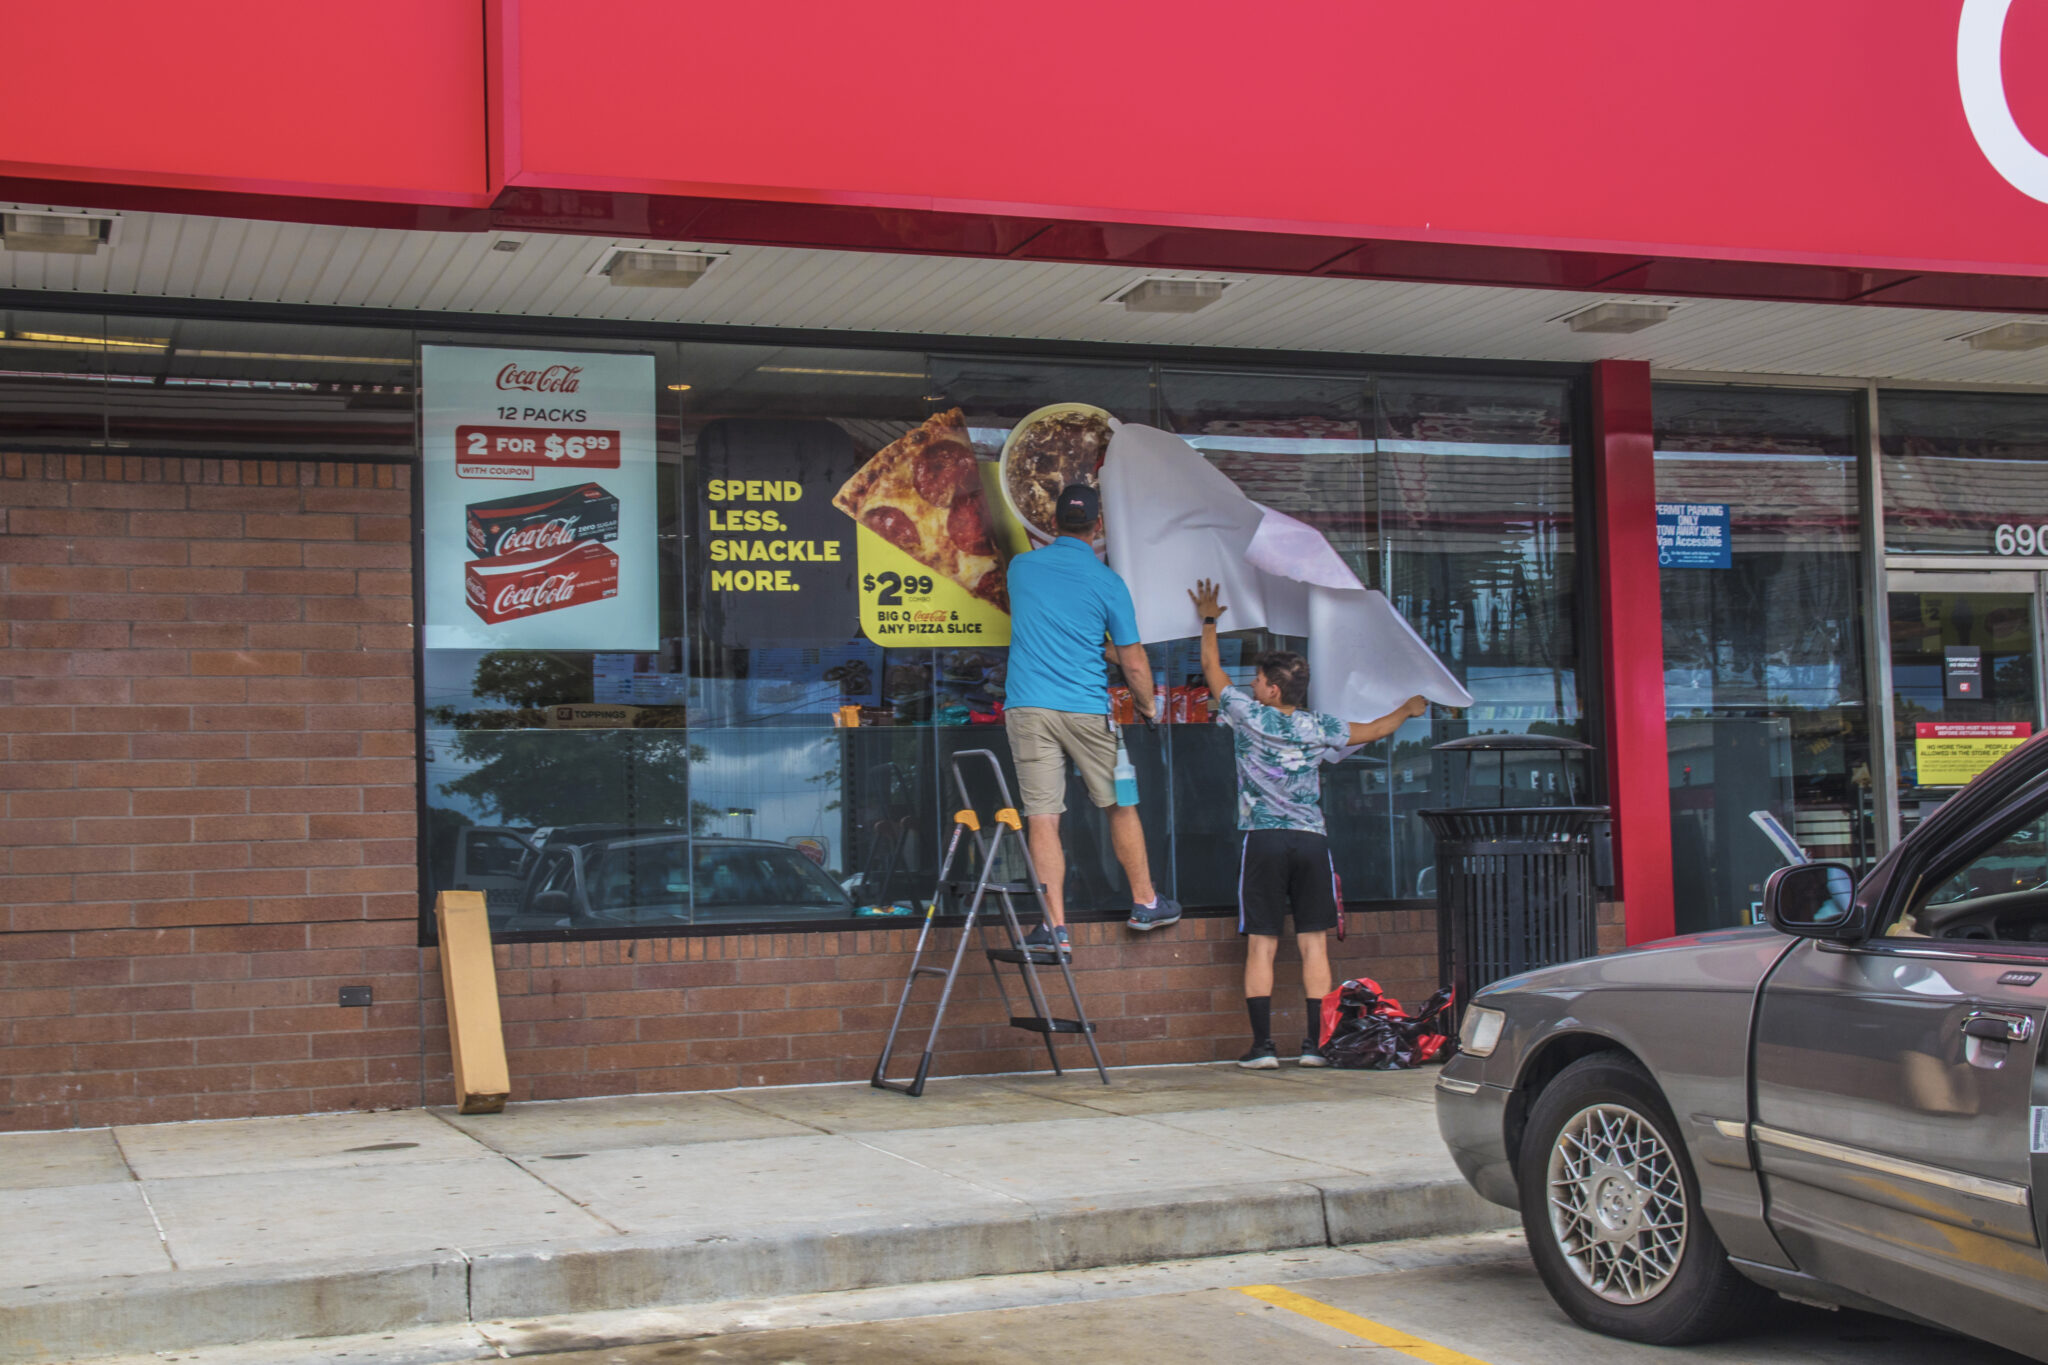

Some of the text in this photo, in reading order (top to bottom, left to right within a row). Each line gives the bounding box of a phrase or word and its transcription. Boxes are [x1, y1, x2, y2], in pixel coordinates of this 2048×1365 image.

[496, 363, 584, 393] Coca-Cola
[497, 407, 587, 422] 12 PACKS
[467, 432, 488, 455] 2
[496, 438, 536, 453] FOR
[462, 466, 530, 475] WITH COUPON
[708, 479, 803, 502] SPEND
[1686, 505, 1724, 516] PARKING
[709, 510, 787, 532] LESS.
[1677, 515, 1699, 525] ONLY
[495, 514, 582, 556] Coca-Cola
[1656, 525, 1722, 537] TOW AWAY ZONE
[1675, 536, 1722, 547] Accessible
[710, 540, 841, 562] SNACKLE
[711, 570, 800, 592] MORE.
[493, 571, 581, 614] Coca-Cola
[878, 610, 959, 622] BIG Q Coca-Cola &
[878, 623, 983, 634] ANY PIZZA SLICE
[574, 710, 626, 719] TOPPINGS
